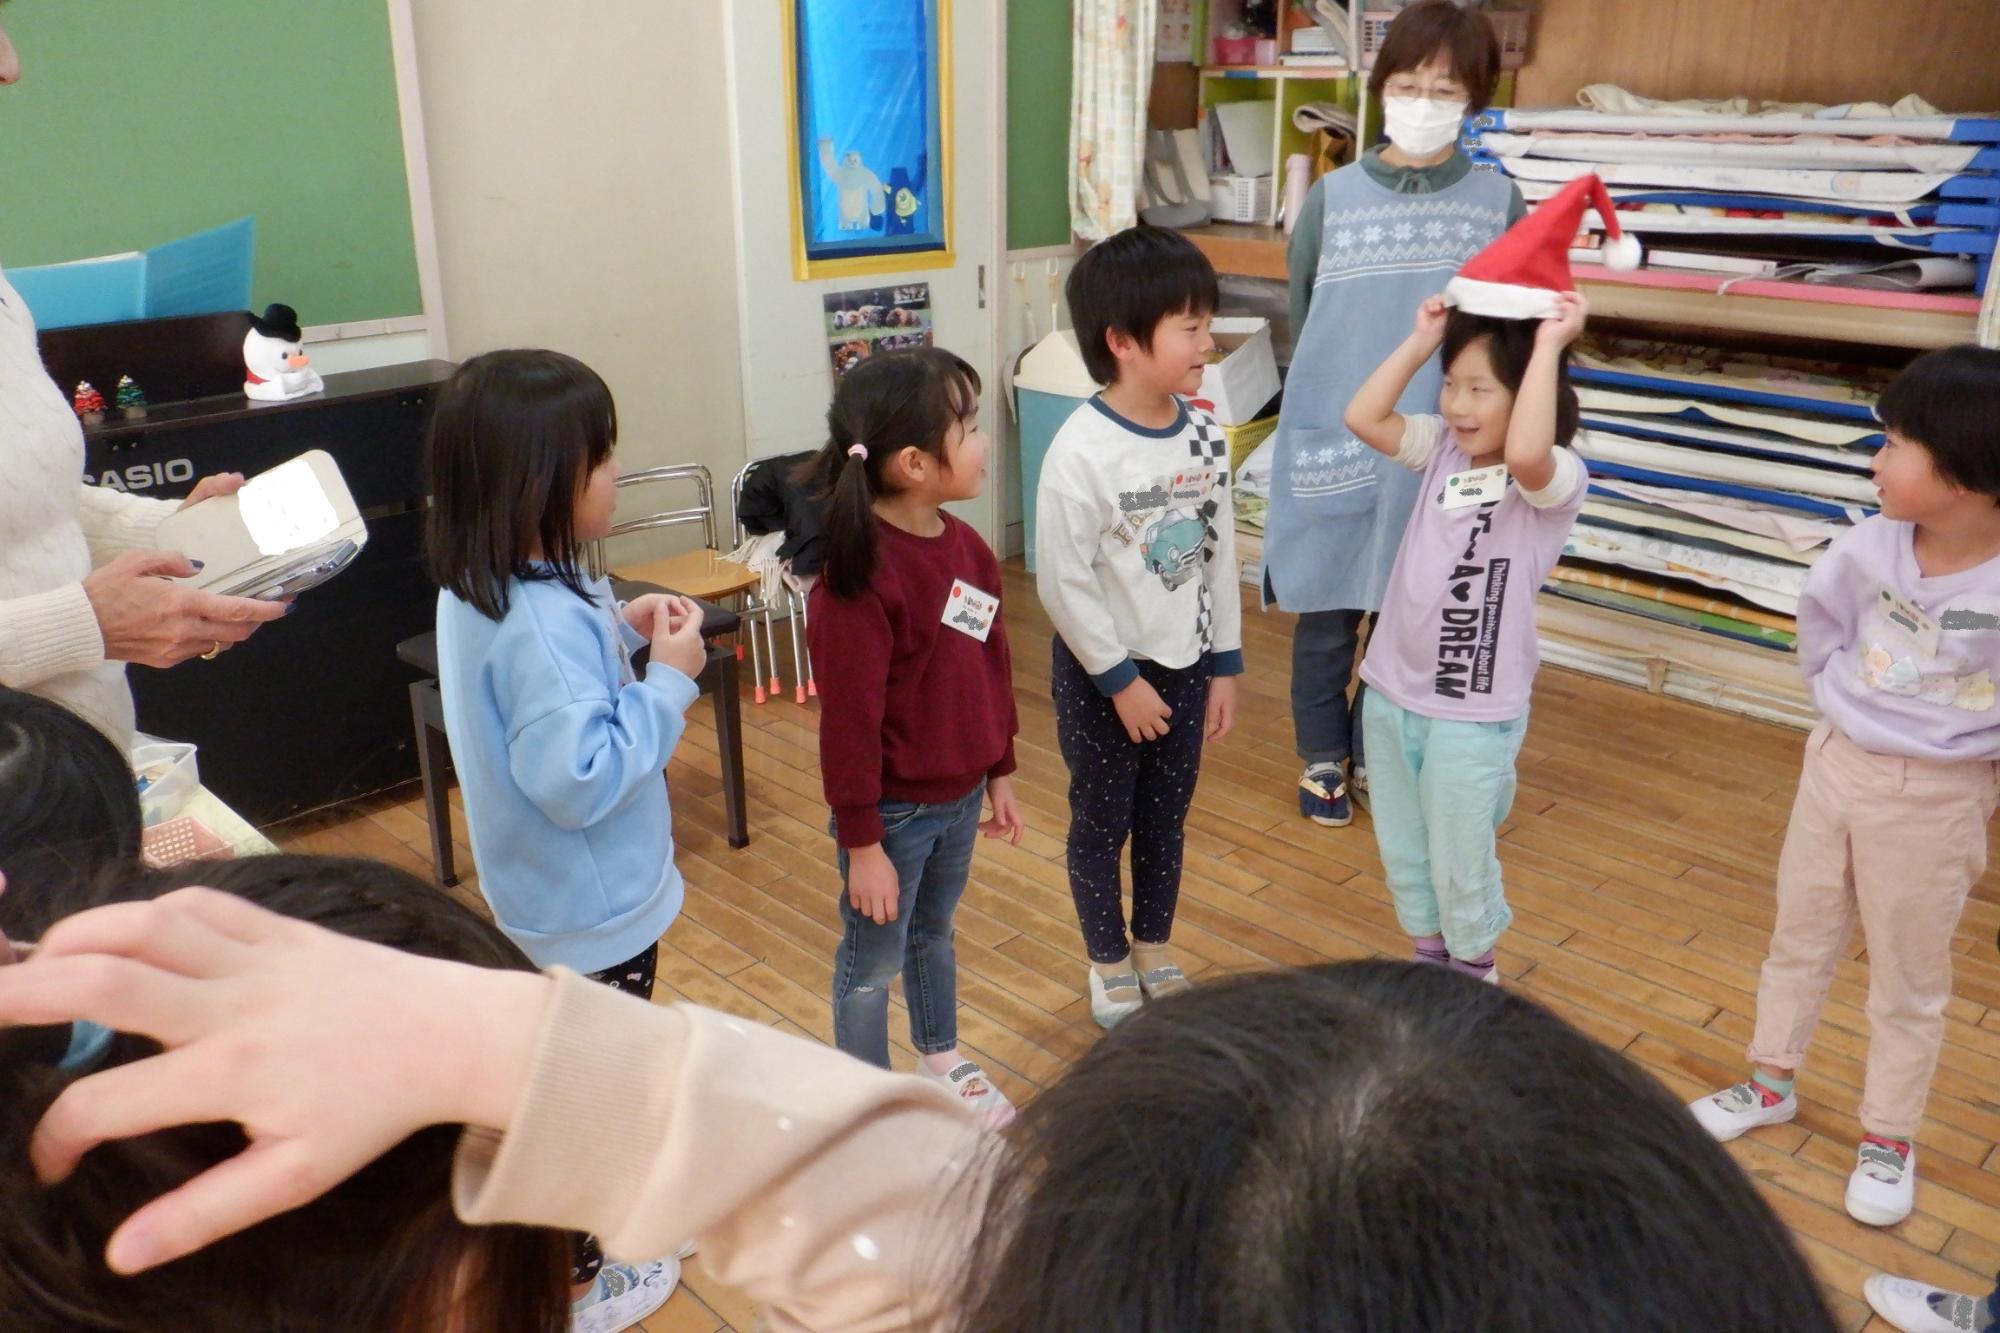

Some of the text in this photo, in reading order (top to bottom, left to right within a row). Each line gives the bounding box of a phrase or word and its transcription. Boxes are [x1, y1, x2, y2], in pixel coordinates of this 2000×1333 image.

[1435, 608, 1480, 700] DREAM
[1475, 561, 1506, 691] Thinking positively about life
